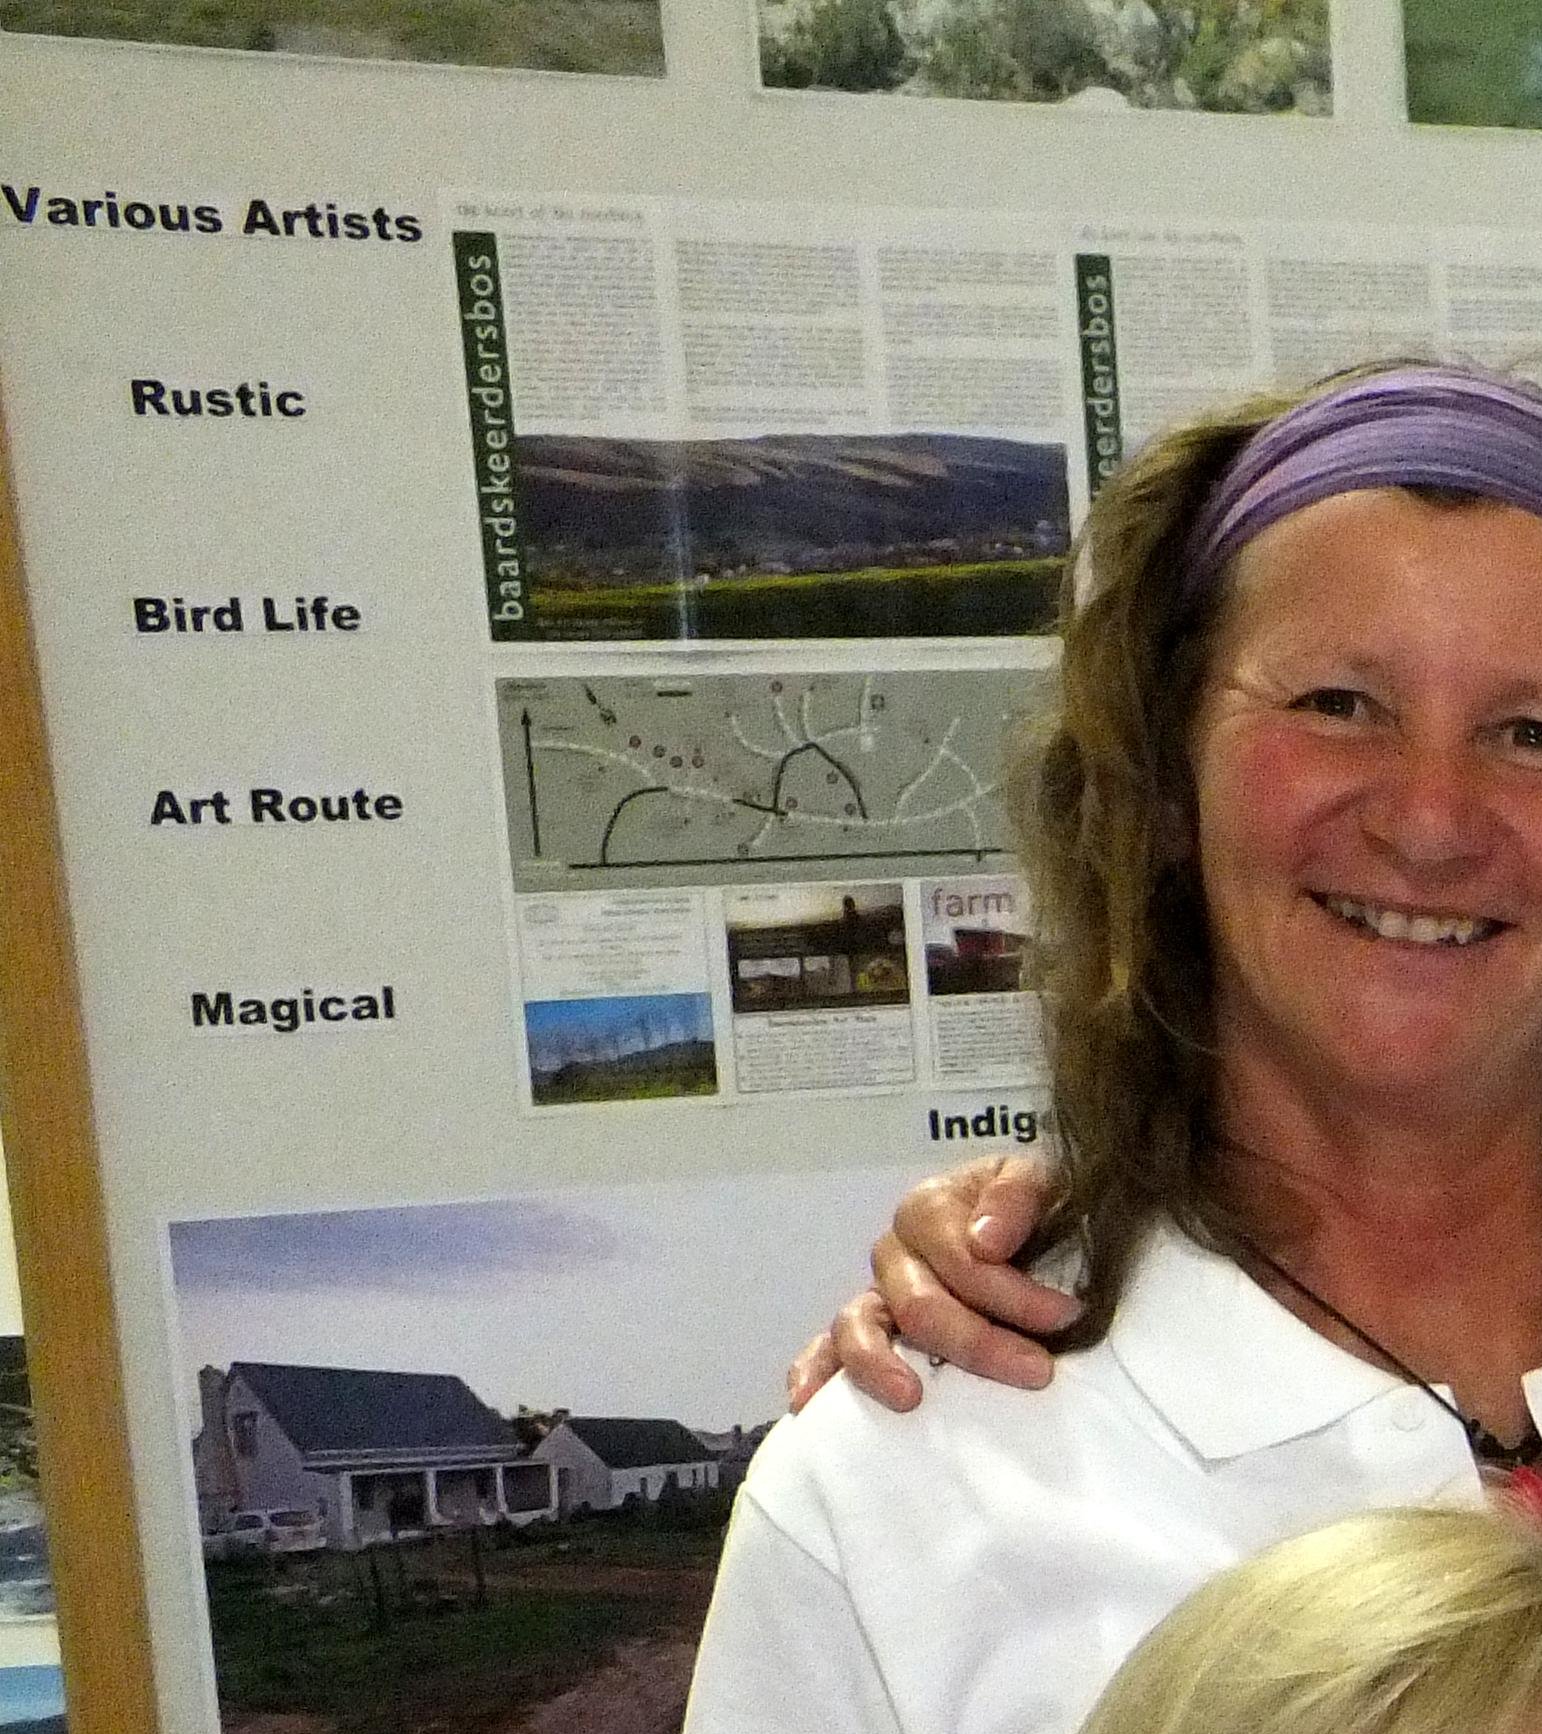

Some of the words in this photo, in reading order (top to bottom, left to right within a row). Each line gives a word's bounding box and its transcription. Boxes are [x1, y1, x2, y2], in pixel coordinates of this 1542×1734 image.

[1, 184, 223, 234] Various
[243, 200, 423, 242] Artists
[1080, 274, 1119, 479] eerdersbos
[132, 379, 306, 418] Rustic
[464, 254, 525, 622] baardskeerdersbos
[134, 597, 243, 633] Bird
[264, 597, 361, 632] Life
[150, 790, 232, 825] Art
[250, 788, 403, 824] Route
[931, 888, 1014, 918] farm
[191, 985, 396, 1033] Magical
[928, 1104, 1038, 1143] Indig
